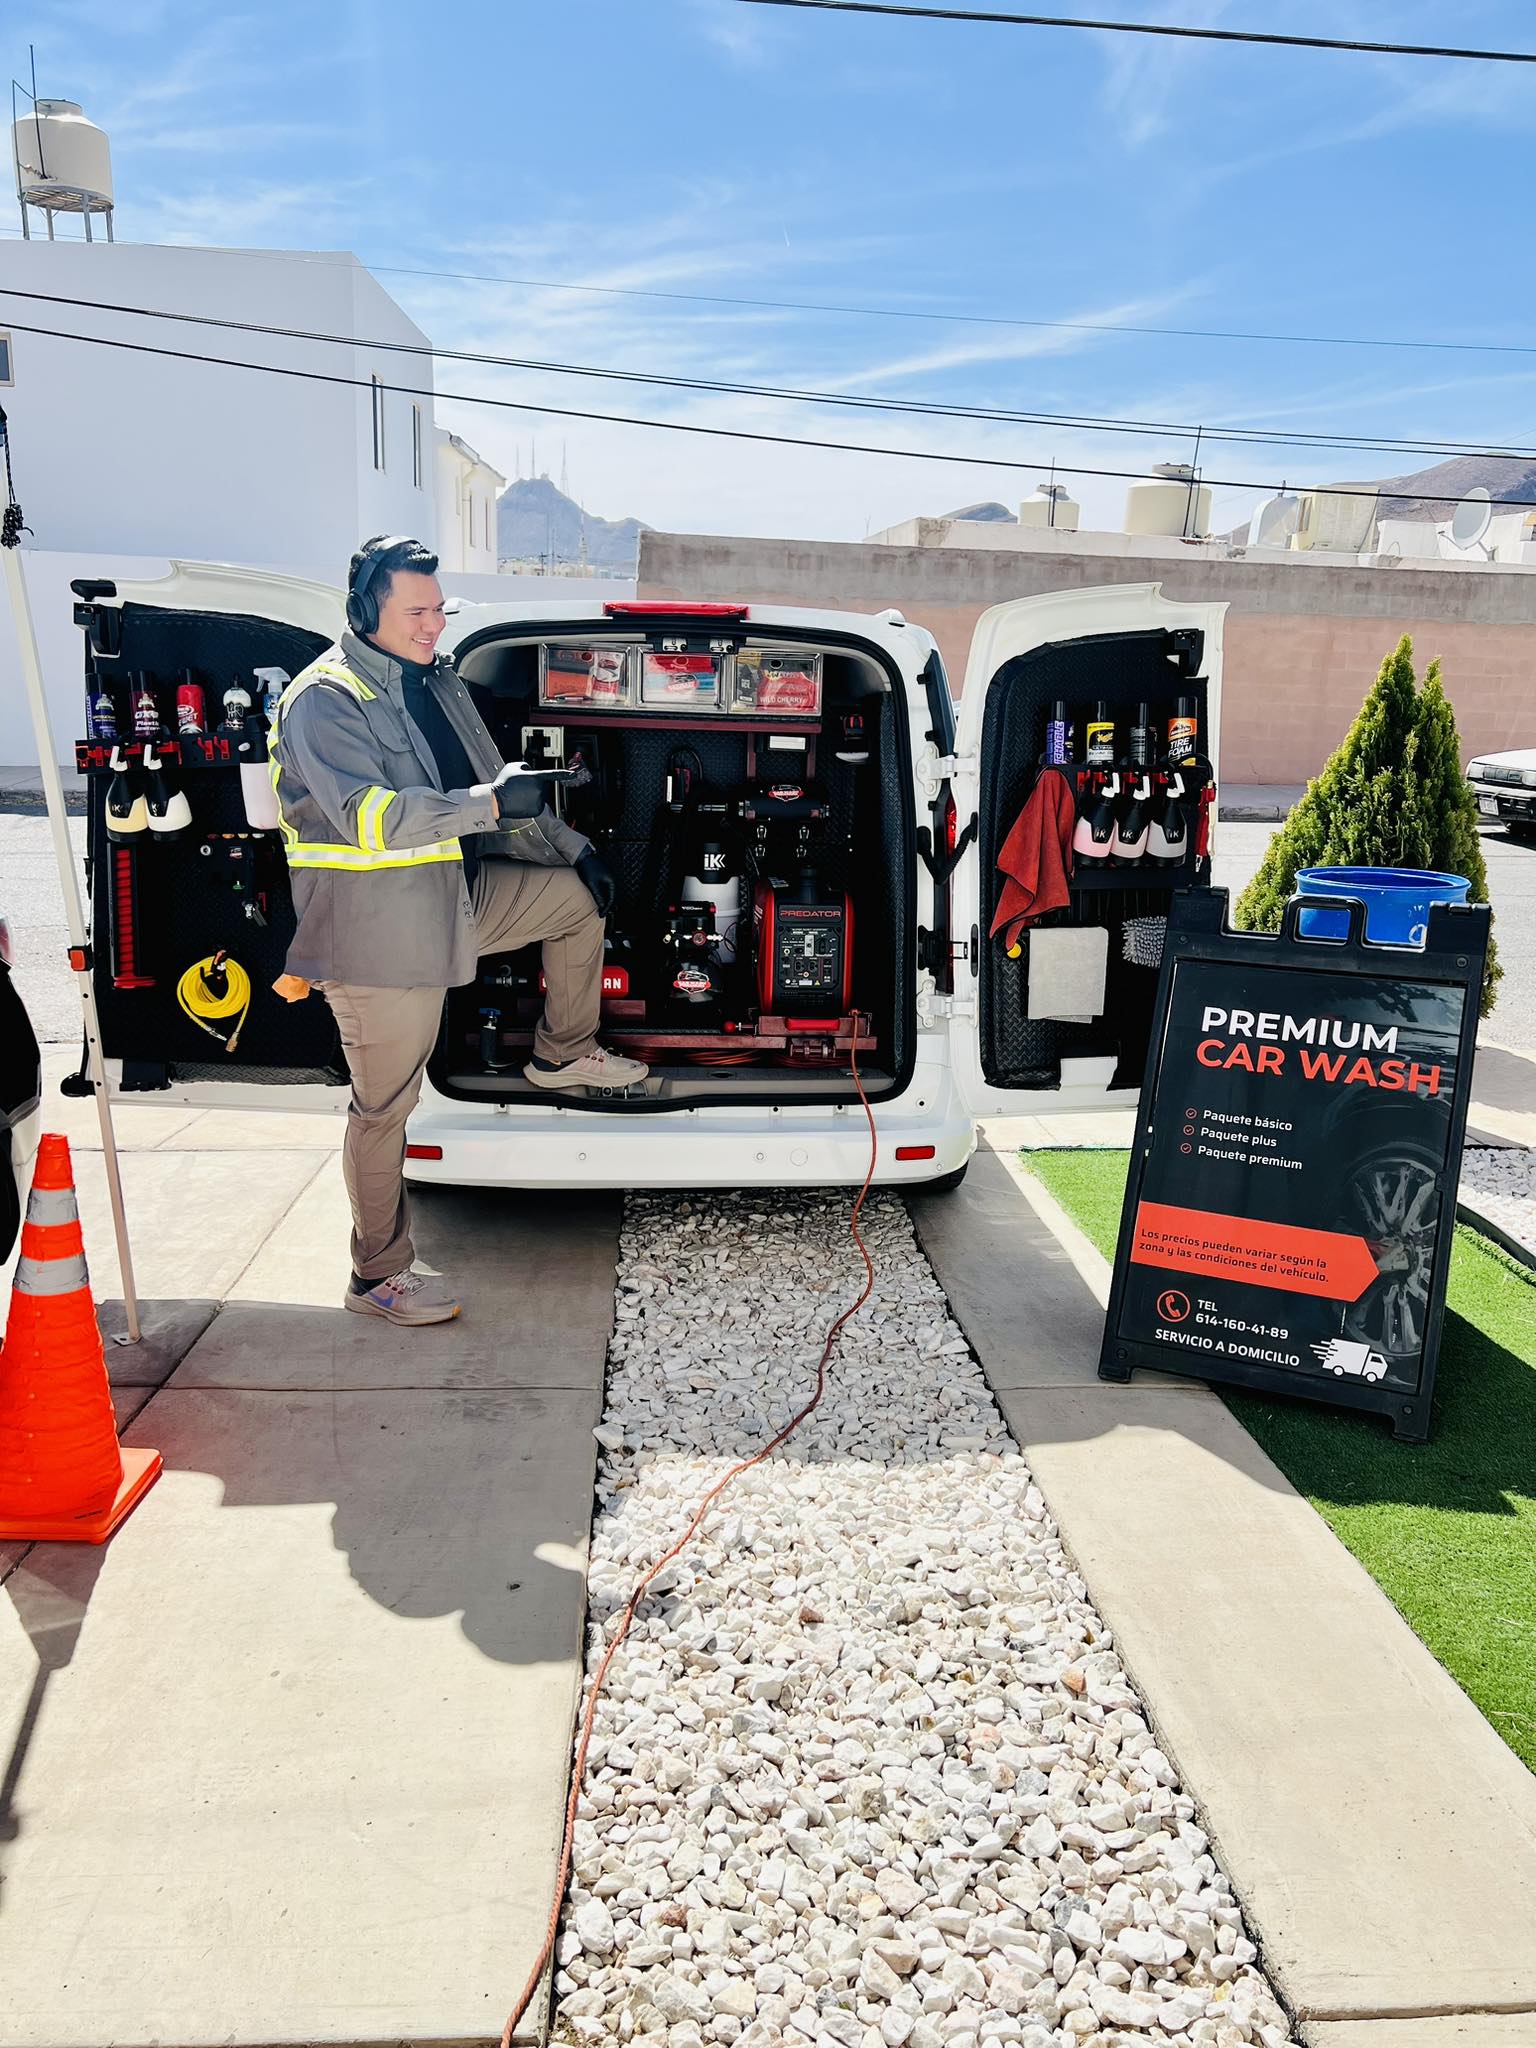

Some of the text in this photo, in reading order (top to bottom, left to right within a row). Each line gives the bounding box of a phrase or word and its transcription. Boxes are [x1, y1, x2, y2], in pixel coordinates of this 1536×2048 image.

[777, 696, 802, 704] CHERRY
[1168, 744, 1193, 758] FOAM
[1170, 737, 1190, 749] TIRE
[780, 909, 841, 918] PREDATOR
[1202, 1006, 1398, 1054] PREMIUM
[1197, 1039, 1440, 1094] CAR WASH
[1203, 1109, 1293, 1131] Paquete básico
[1201, 1127, 1277, 1148] Paquete plus
[1198, 1145, 1303, 1170] Paquete premium
[1141, 1229, 1327, 1268] Los precios pueden variar según la
[1139, 1243, 1329, 1283] zona y las condiciones del vehículo.
[1197, 1299, 1218, 1312] TEL
[1195, 1313, 1289, 1339] 614-160-41-89
[1155, 1329, 1300, 1366] SERVICIO A DOMICILIO
